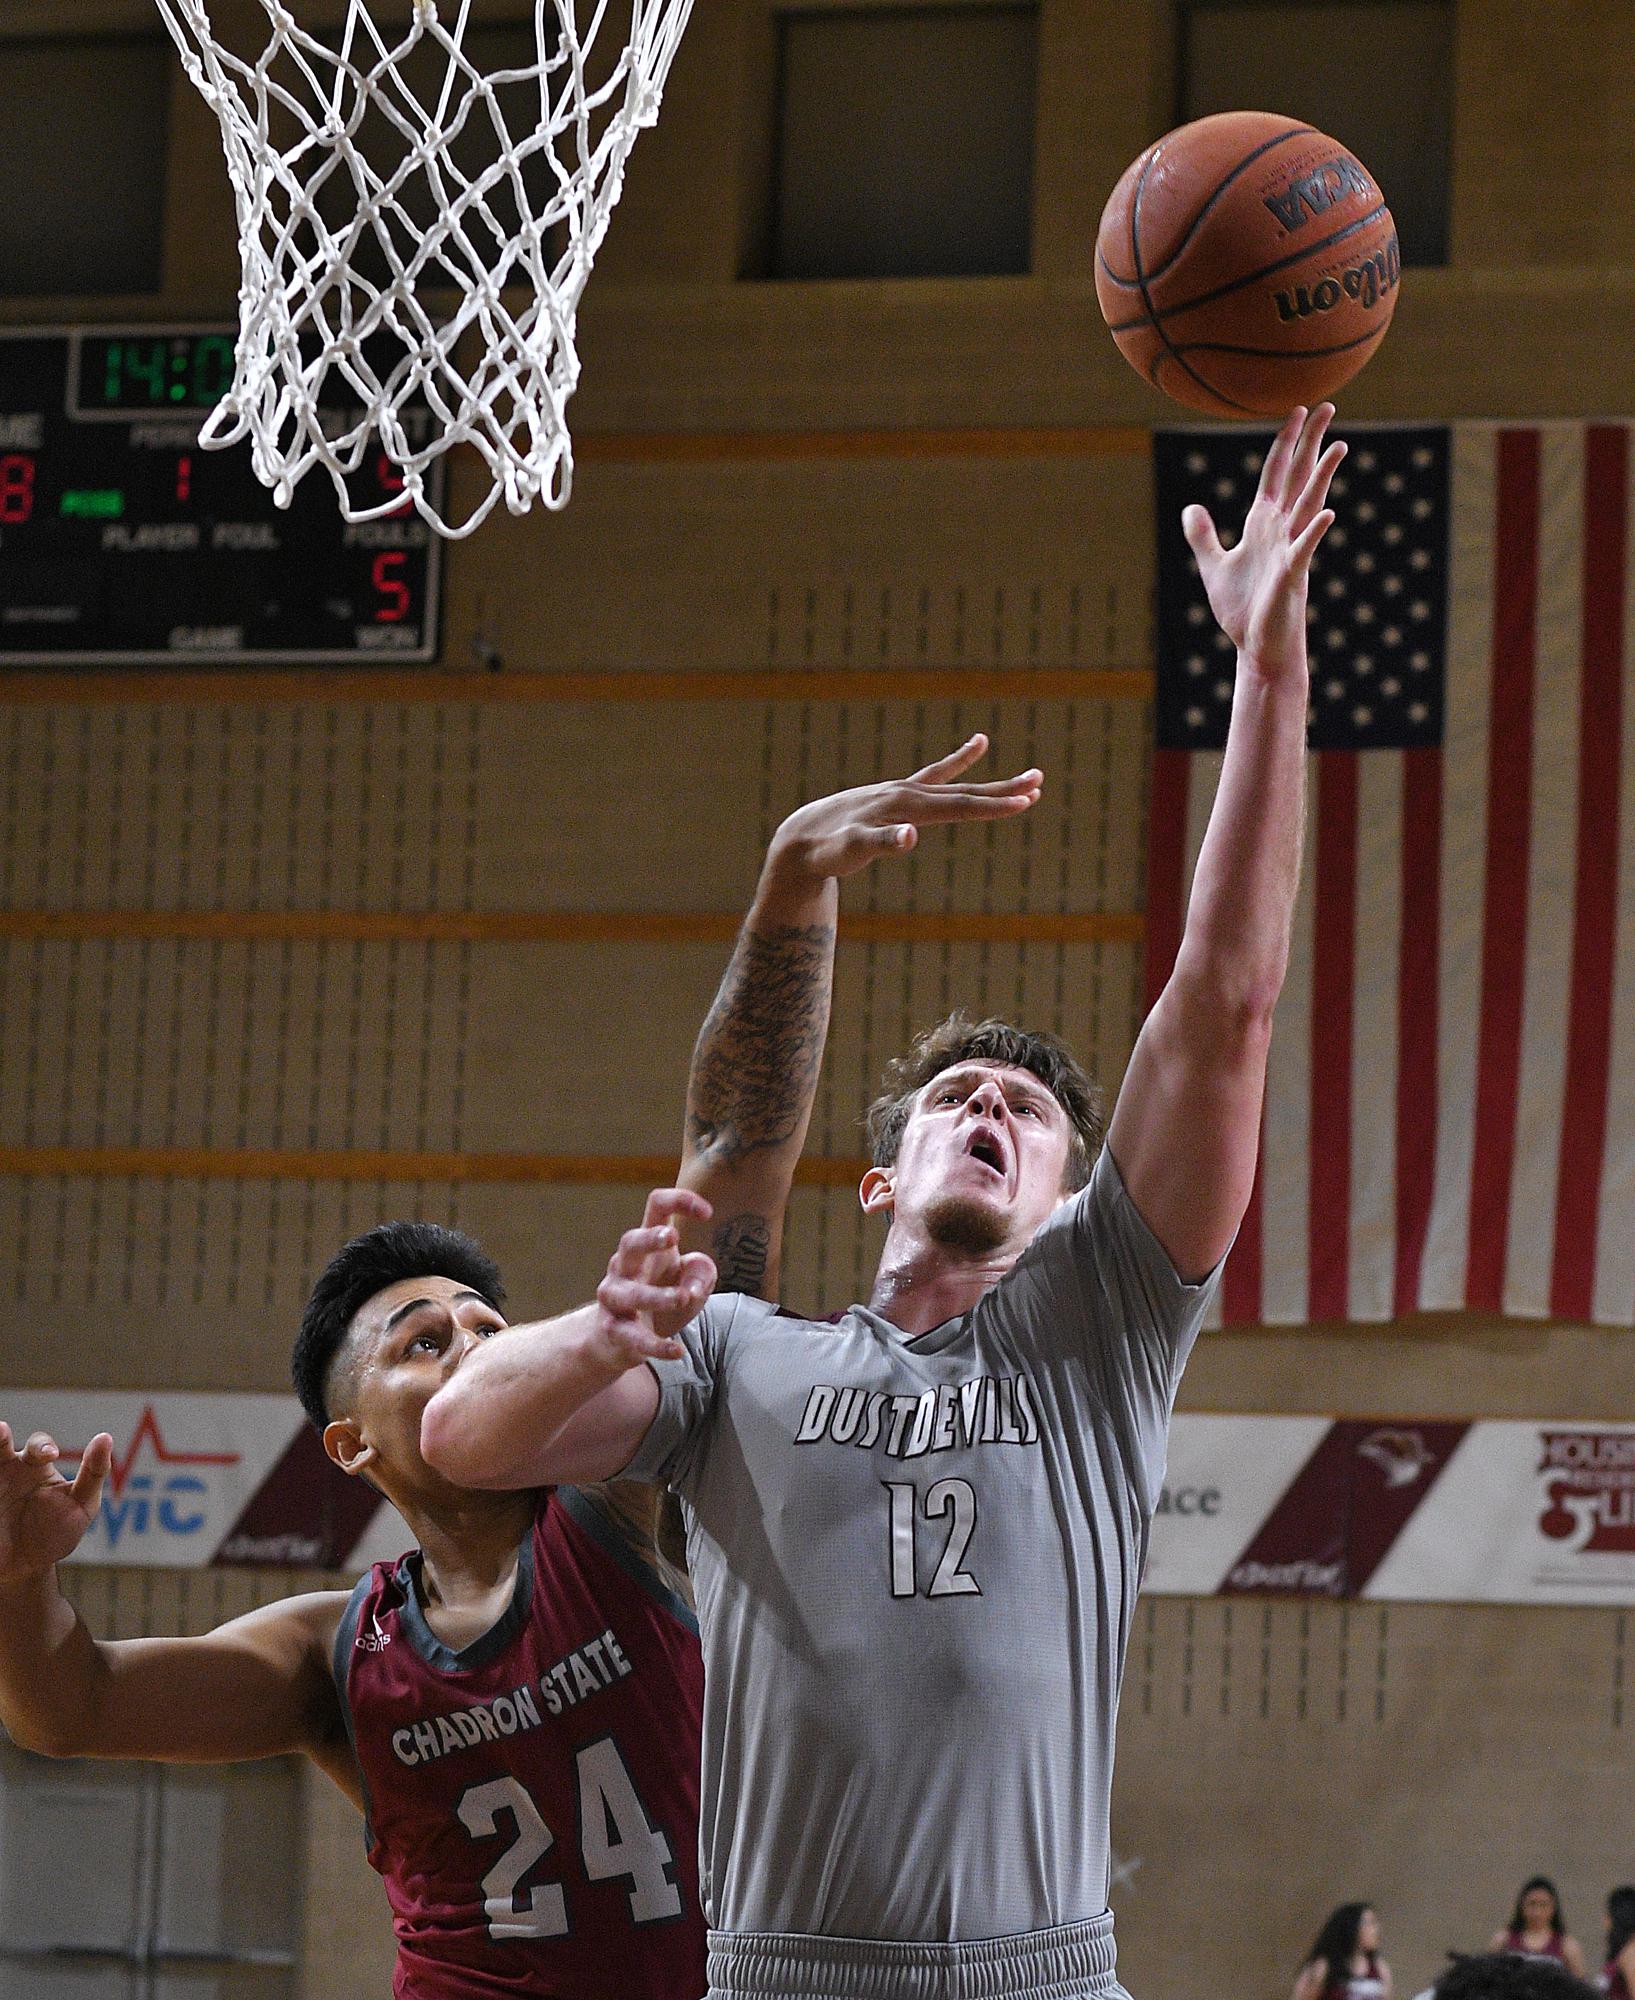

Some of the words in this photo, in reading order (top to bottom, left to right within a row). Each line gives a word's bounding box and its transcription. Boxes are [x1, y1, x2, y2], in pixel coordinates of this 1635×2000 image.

[1264, 157, 1372, 233] NCAA
[104, 337, 272, 404] 14:0
[177, 456, 191, 500] 1
[372, 551, 410, 621] 5
[793, 1373, 1039, 1461] DUSTDEVILS
[881, 1477, 983, 1598] 12
[391, 1685, 543, 1767] CHADRON
[539, 1628, 634, 1716] STATE
[456, 1736, 683, 1940] 24
